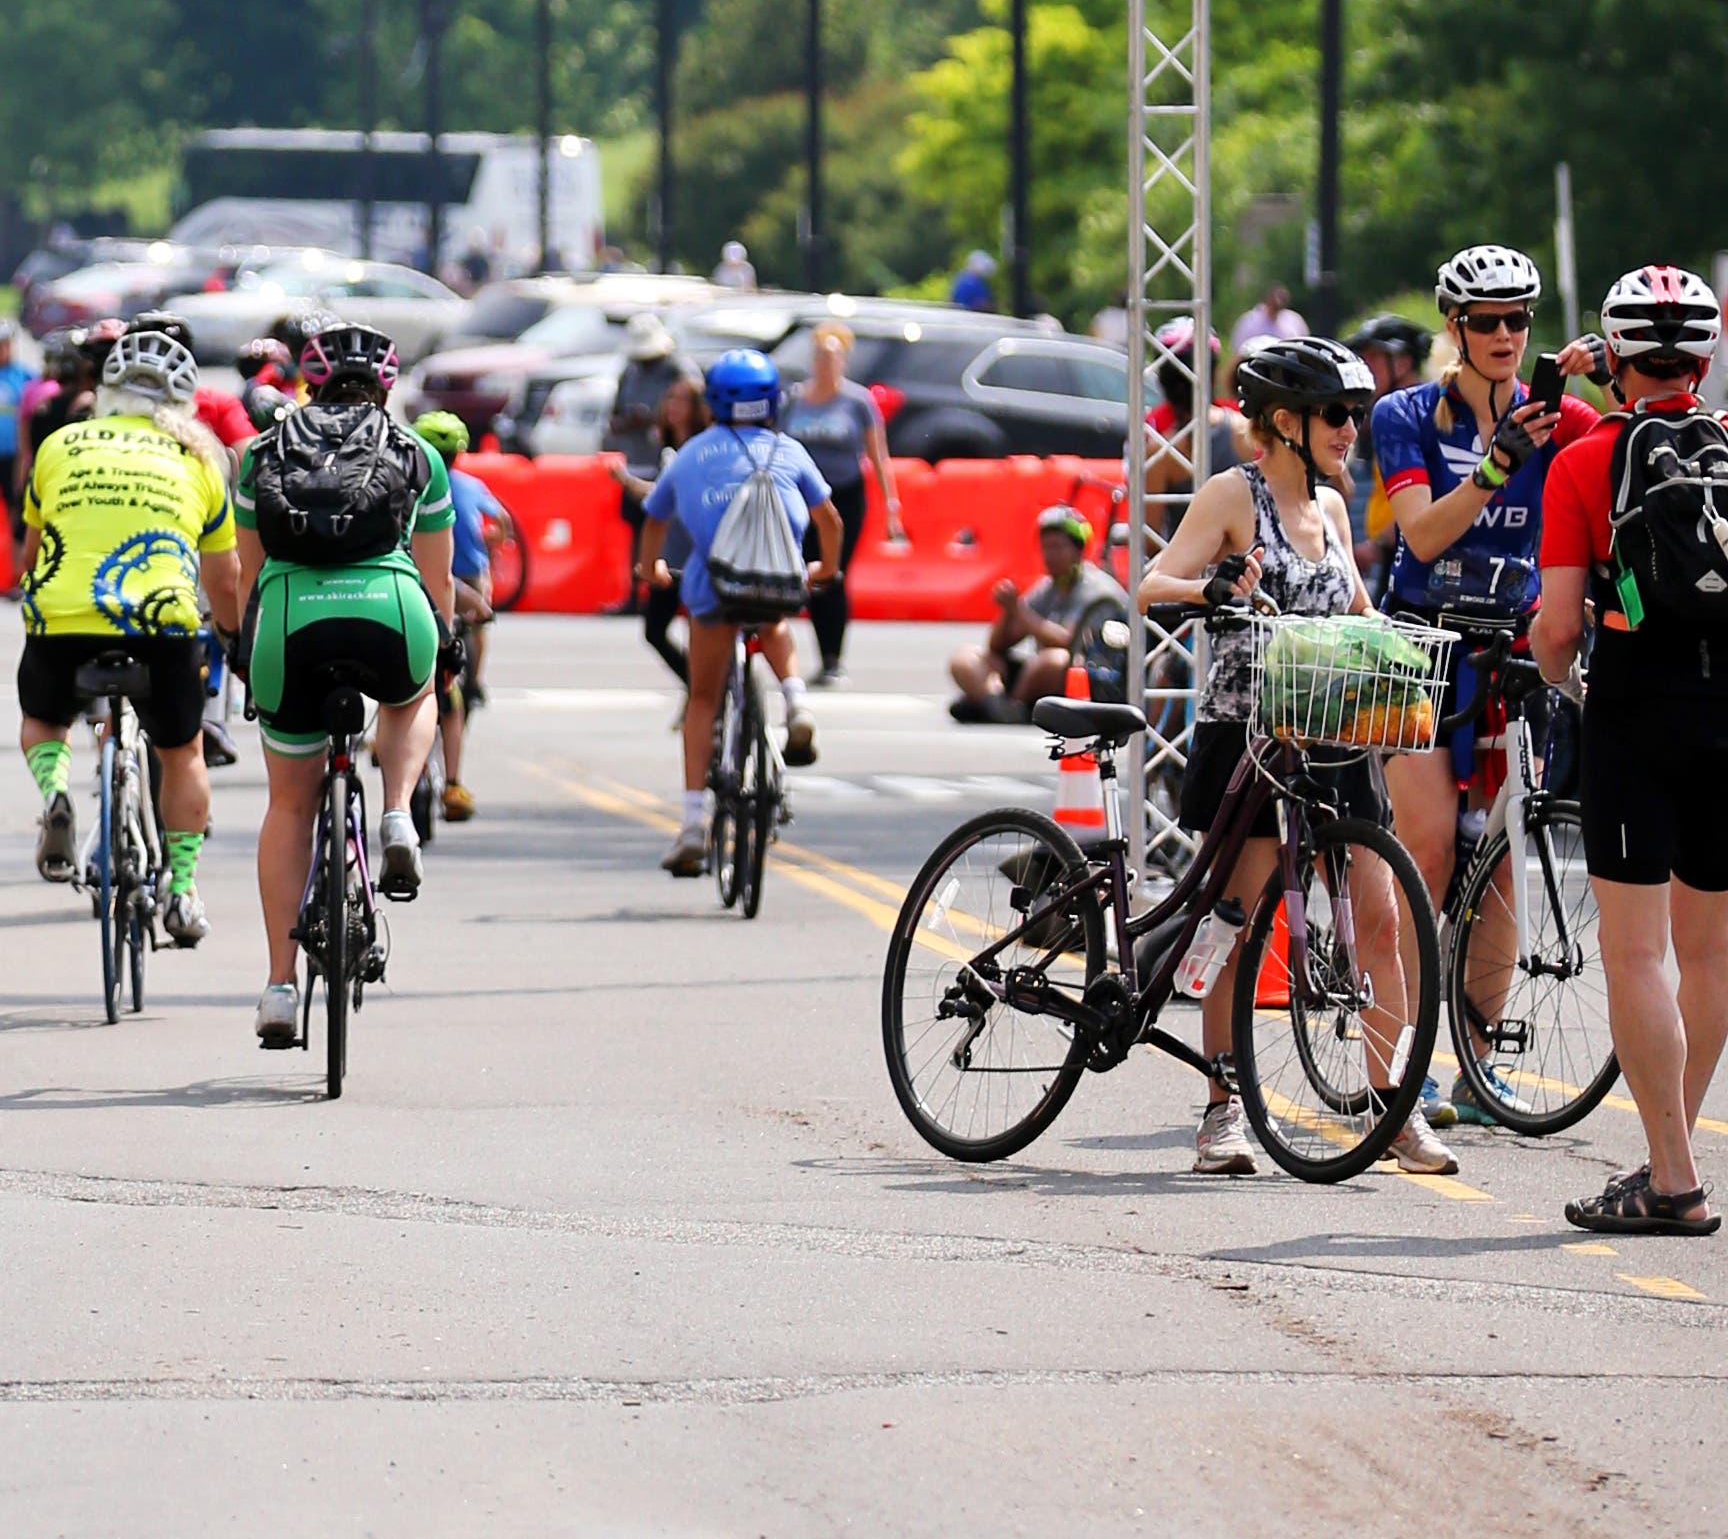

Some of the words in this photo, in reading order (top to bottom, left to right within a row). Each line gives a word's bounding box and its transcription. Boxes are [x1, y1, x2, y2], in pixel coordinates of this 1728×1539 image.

[64, 430, 114, 445] OLD
[69, 469, 91, 478] Age
[83, 481, 129, 492] Always
[57, 499, 81, 512] Over
[87, 496, 125, 507] Youth
[1489, 556, 1506, 595] 7
[299, 592, 388, 601] www.skirack.com
